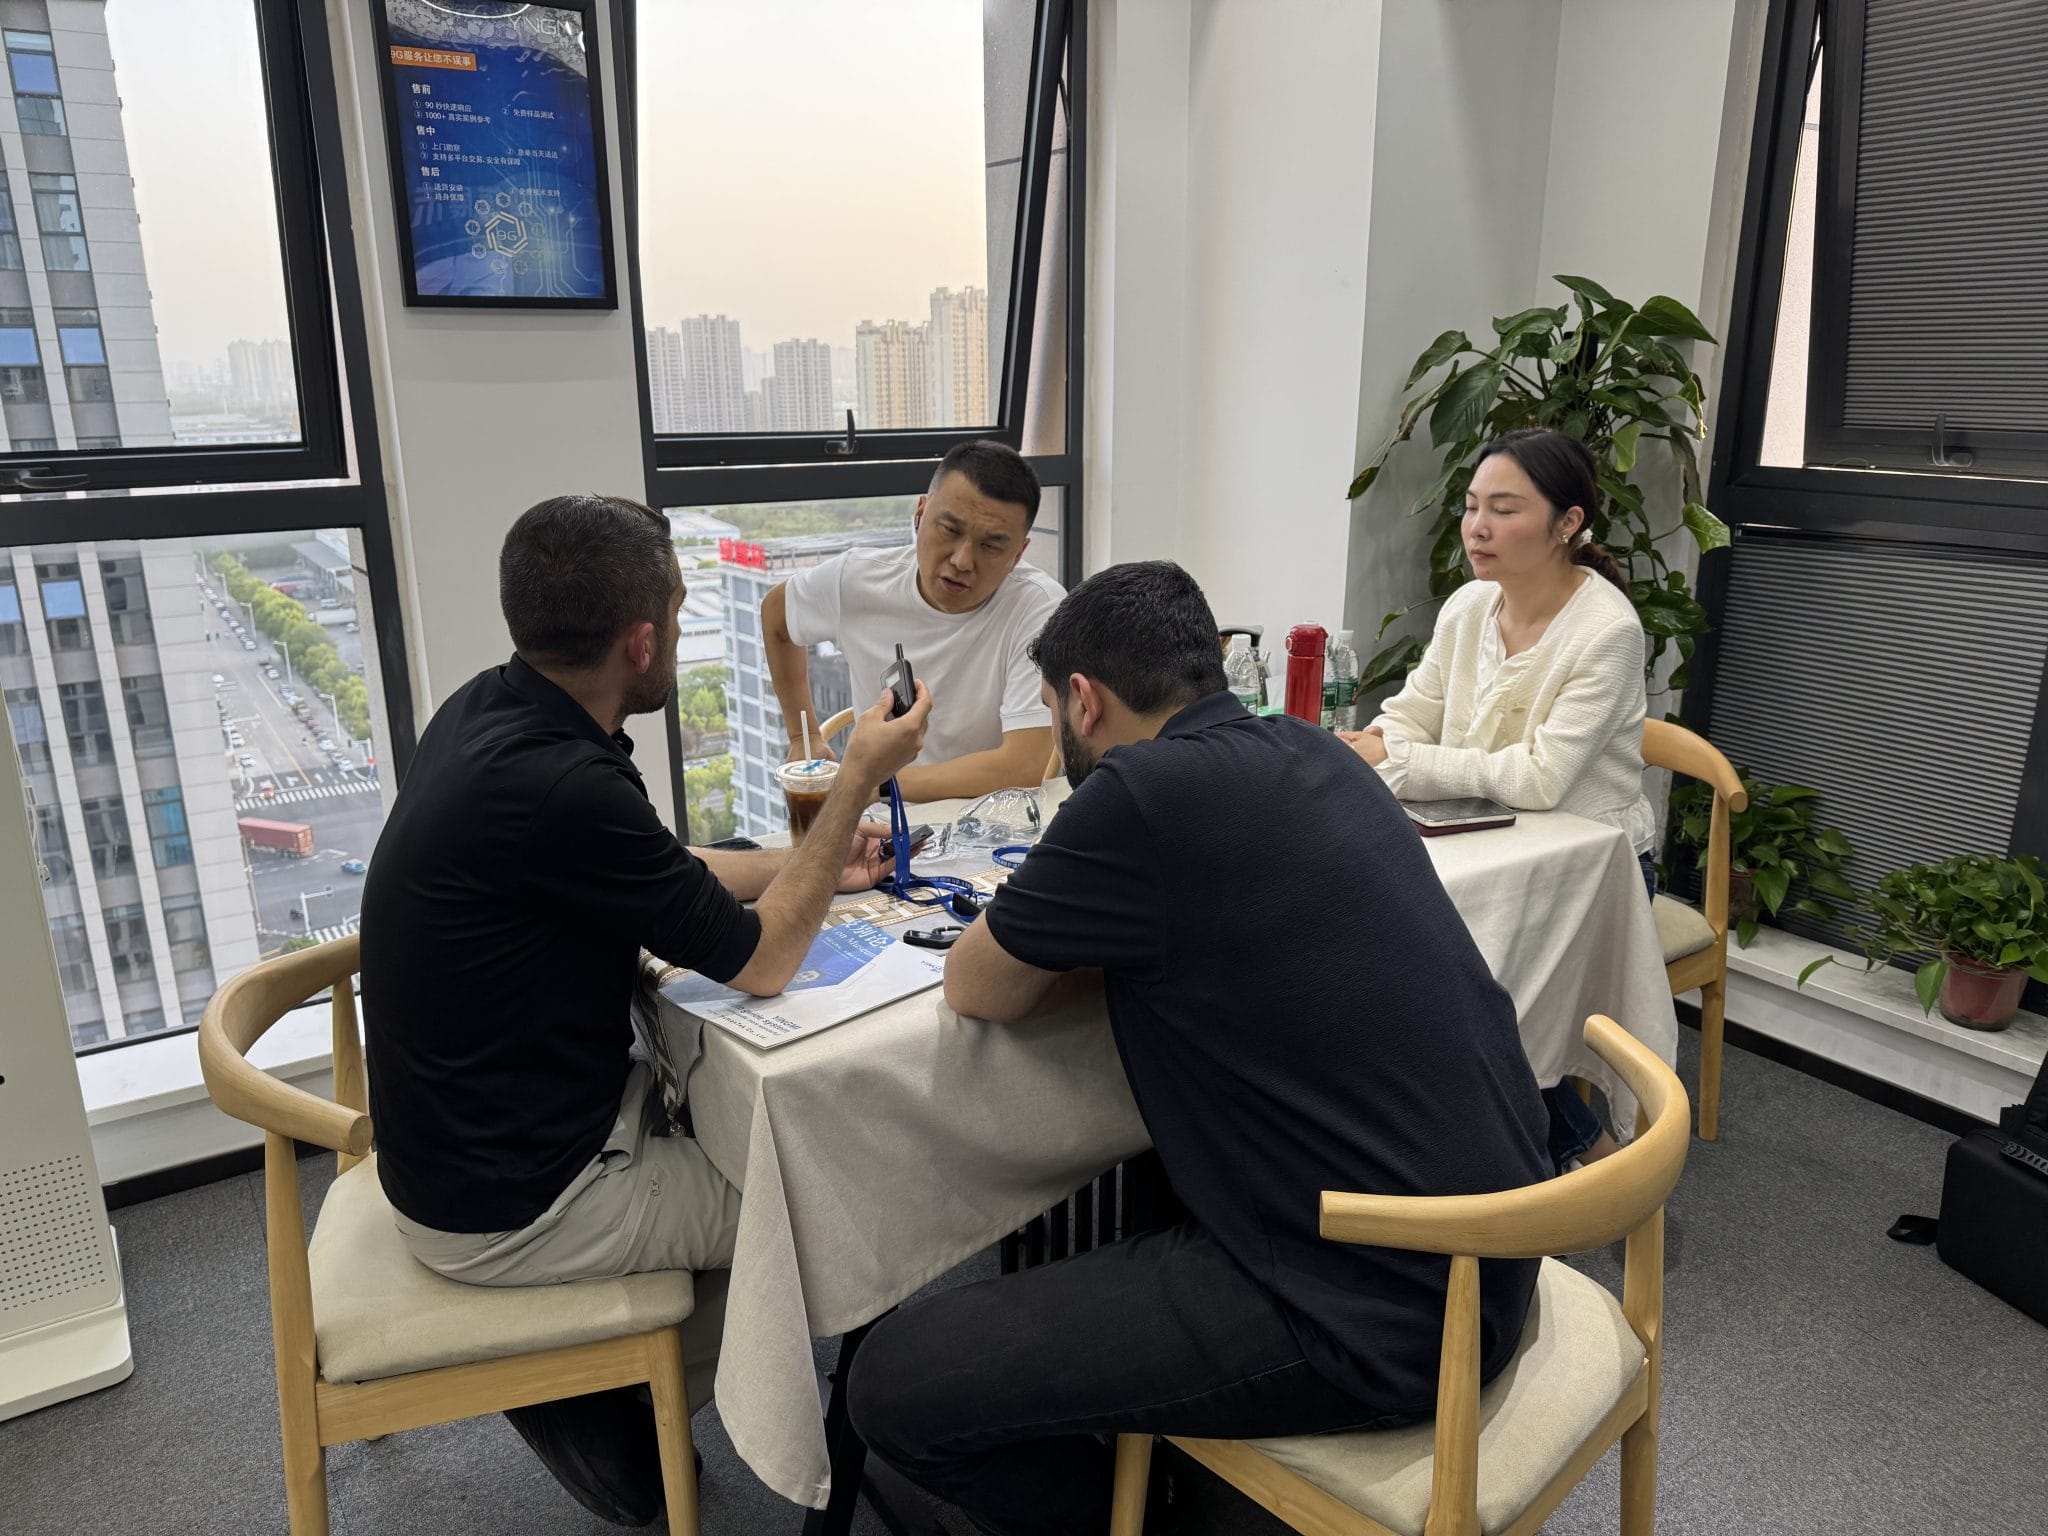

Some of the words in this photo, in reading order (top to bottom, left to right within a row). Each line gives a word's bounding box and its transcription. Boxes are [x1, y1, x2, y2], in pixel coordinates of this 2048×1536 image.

[411, 83, 432, 95] 售前
[425, 111, 446, 120] 1000+
[415, 125, 436, 136] 售中
[420, 165, 441, 177] 售后
[496, 230, 518, 241] 9G
